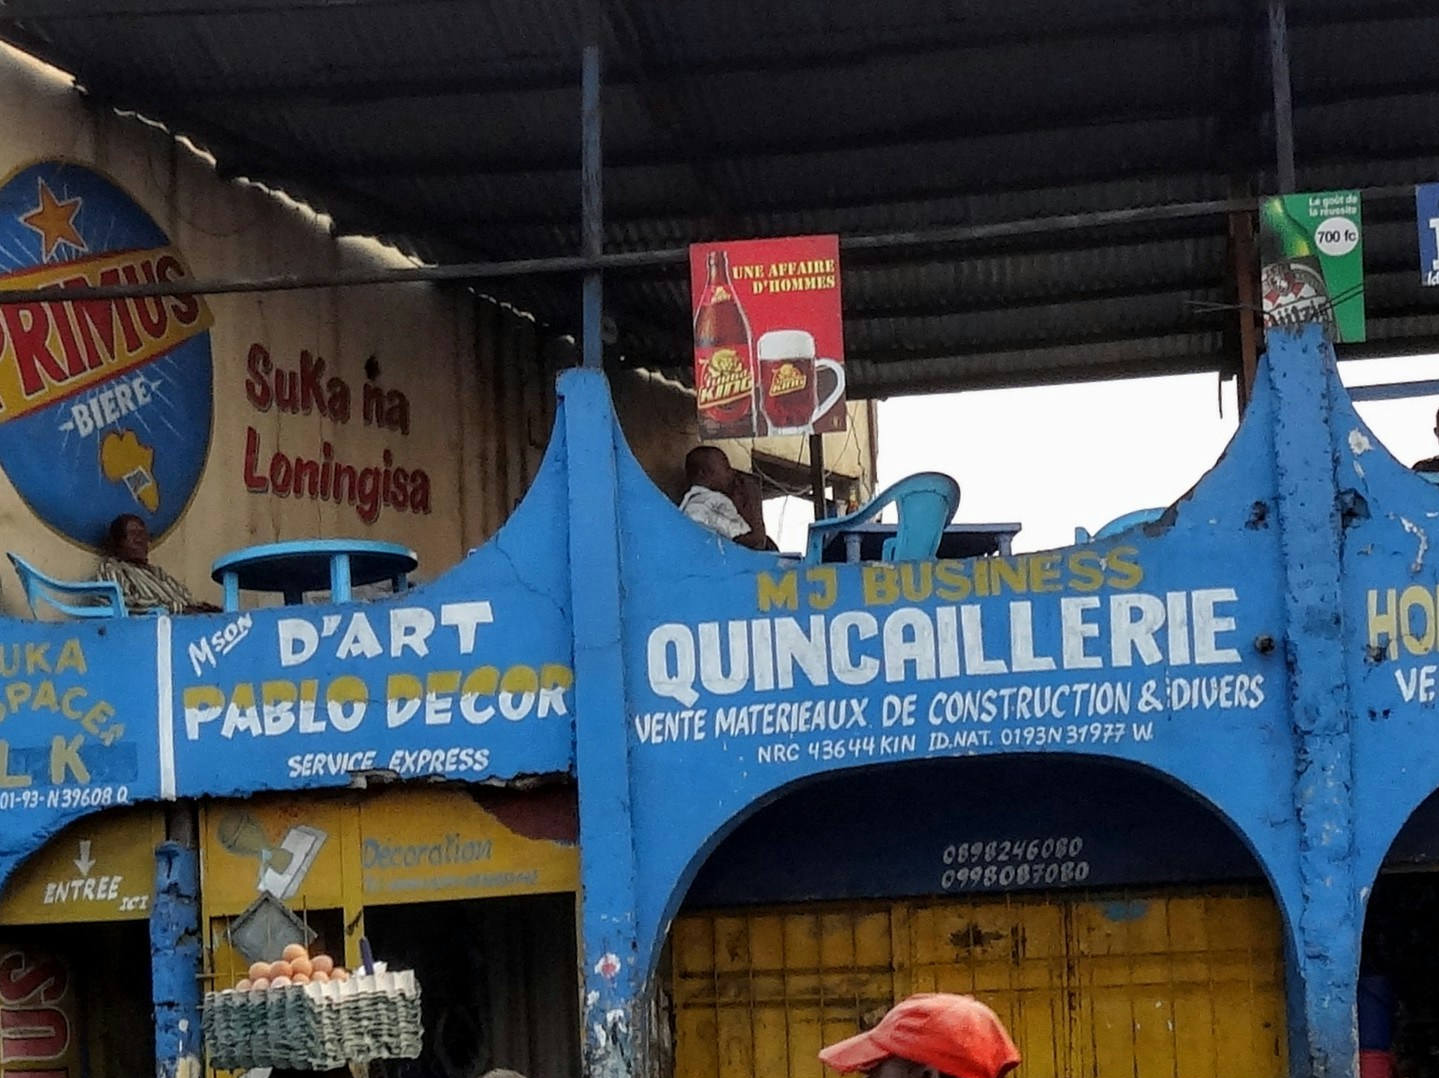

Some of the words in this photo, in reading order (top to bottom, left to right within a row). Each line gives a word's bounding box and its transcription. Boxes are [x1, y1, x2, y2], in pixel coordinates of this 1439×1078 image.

[1318, 231, 1340, 244] 700
[732, 265, 764, 280] UNE
[768, 259, 835, 278] AFFAIRE
[752, 275, 835, 294] D'HOMMES
[243, 427, 431, 525] Loningisa
[859, 547, 1144, 606] BUSINESS
[277, 601, 493, 667] D'ART
[647, 587, 1244, 707] QUINCAILLERIE
[183, 675, 368, 740] PABLO
[386, 663, 573, 729] DECOR
[635, 708, 707, 745] VENTE
[715, 697, 867, 739] MATERIEAUX
[882, 694, 918, 728] DE
[929, 680, 1131, 726] CONSTRUCTION
[1138, 679, 1163, 713] &
[1170, 674, 1265, 711] DIVERS
[50, 734, 91, 785] K
[288, 750, 376, 778] SERVICE
[388, 747, 489, 774] EXPRESS
[759, 744, 799, 765] NRC
[808, 738, 875, 761] 43644
[880, 734, 916, 753] KIN
[43, 874, 122, 904] ENTREE
[119, 895, 149, 911] ICI
